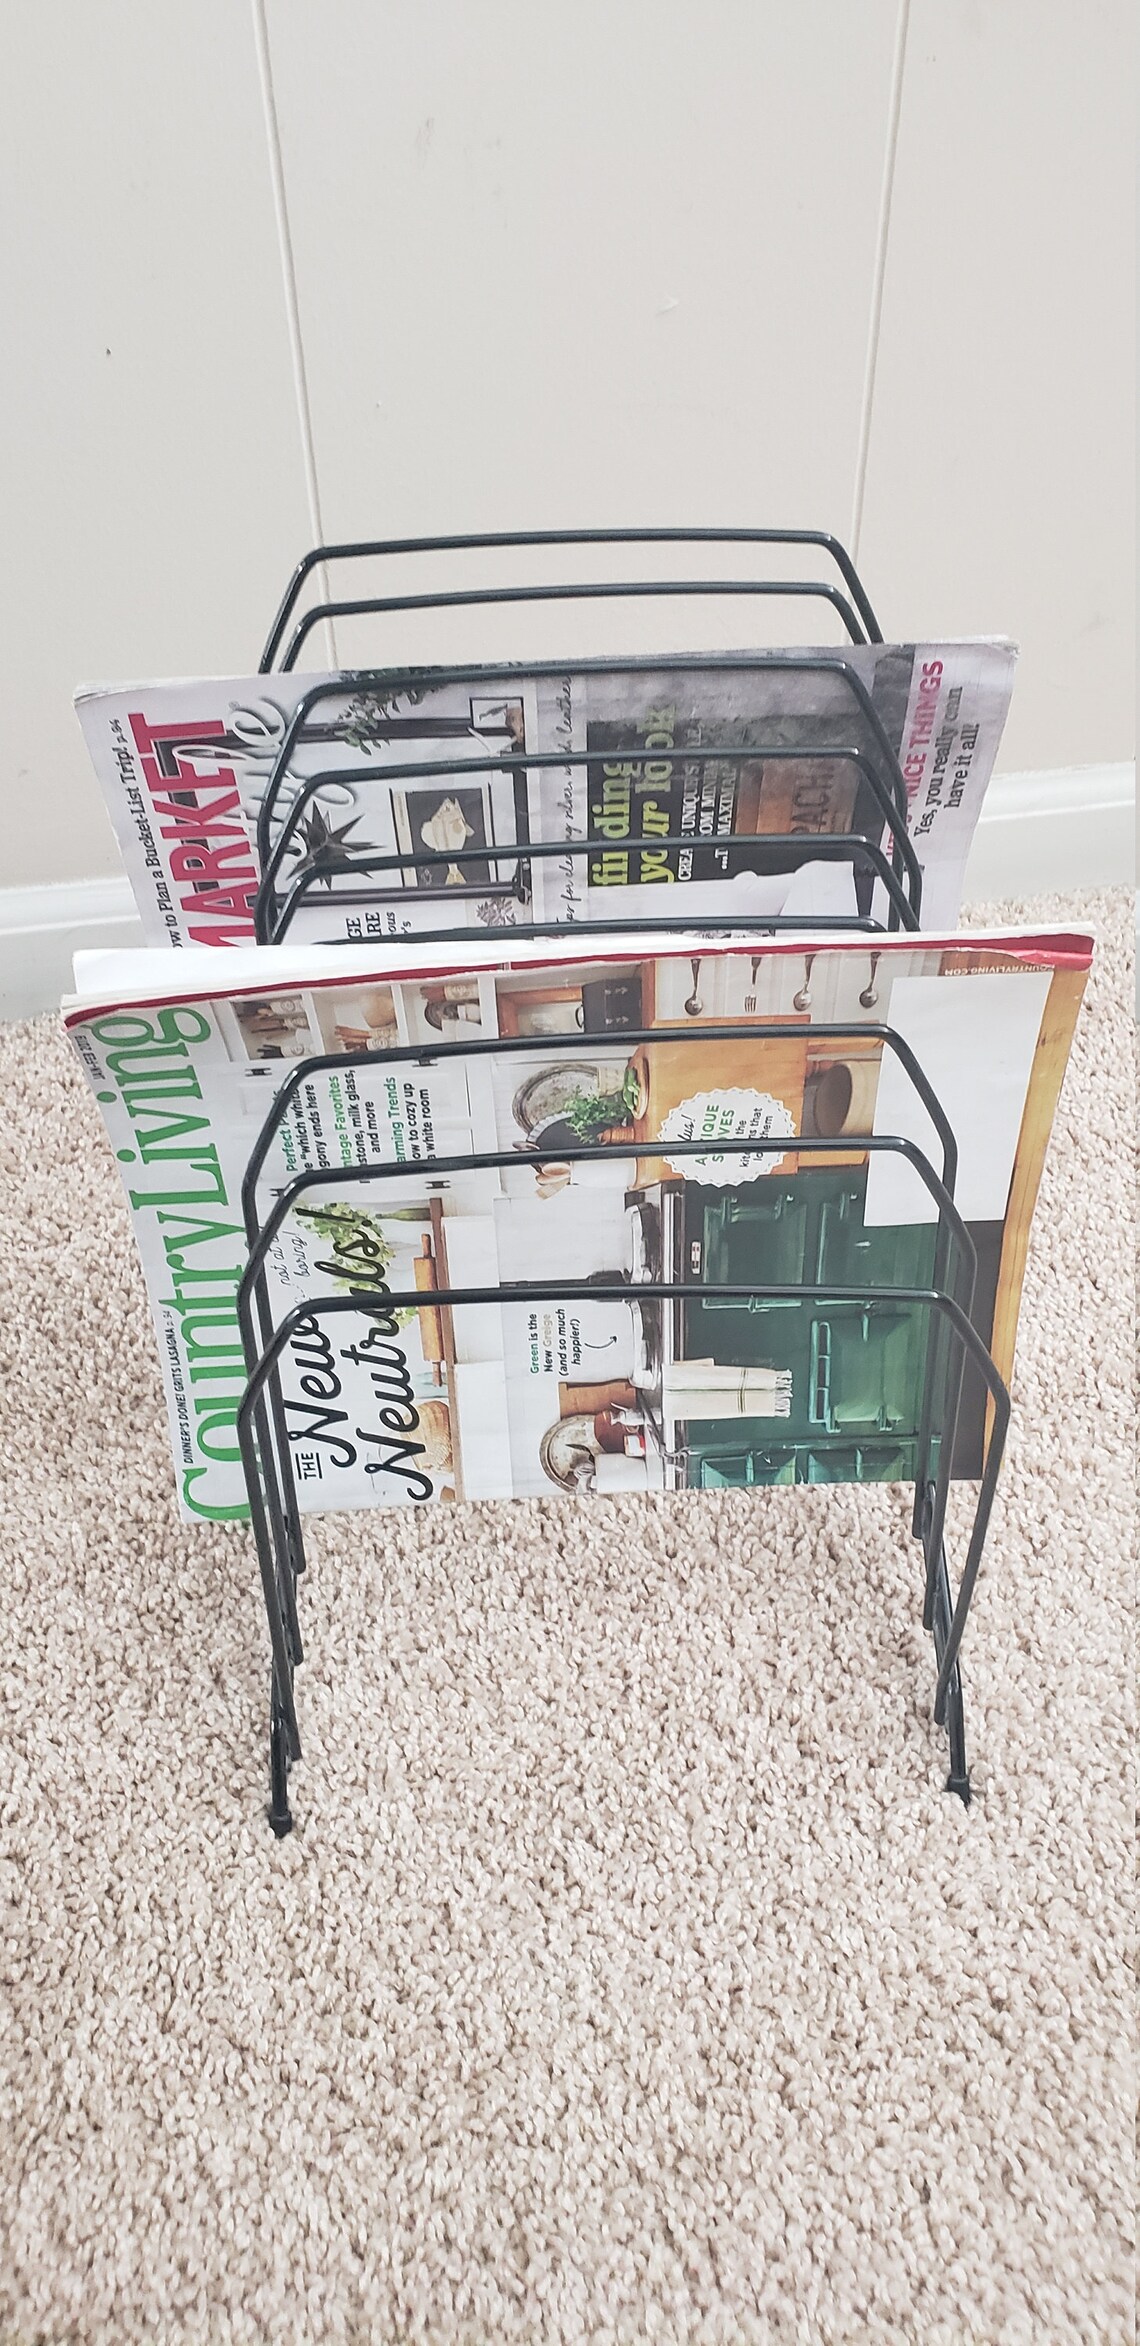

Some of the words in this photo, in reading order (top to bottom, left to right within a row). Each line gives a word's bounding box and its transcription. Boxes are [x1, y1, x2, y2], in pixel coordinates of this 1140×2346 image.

[910, 660, 944, 747] THINGS
[944, 686, 963, 723] can
[931, 724, 959, 774] really
[959, 723, 980, 750] all!
[112, 746, 137, 784] Trip!
[954, 754, 972, 766] it
[924, 776, 941, 806] you
[944, 769, 968, 808] have
[126, 786, 162, 868] Bucket-List
[913, 809, 938, 837] Yes,
[678, 831, 695, 881] CREAE
[152, 870, 164, 879] a
[154, 882, 175, 912] Plan
[164, 914, 178, 927] to
[944, 964, 1048, 976] OUNTRYLIVING.COM
[304, 1084, 318, 1109] here
[342, 1070, 360, 1101] glass,
[384, 1076, 401, 1118] Trends
[402, 1083, 416, 1098] up
[327, 1075, 348, 1130] Favorites
[347, 1103, 362, 1127] milk
[364, 1101, 378, 1130] more
[403, 1100, 418, 1126] cozy
[418, 1088, 432, 1118] room
[308, 1111, 323, 1137] ends
[677, 1114, 696, 1141] lus!
[734, 1120, 747, 1135] the
[749, 1108, 763, 1127] that
[760, 1115, 773, 1139] them
[367, 1132, 381, 1153] and
[390, 1122, 406, 1163] arming
[407, 1129, 419, 1141] to
[420, 1121, 436, 1152] white
[694, 1104, 720, 1166] AIQUE
[711, 1109, 735, 1162] SVES
[280, 1129, 298, 1172] Perfect
[314, 1140, 331, 1168] gony
[336, 1134, 353, 1168] ntage
[411, 1143, 421, 1159] ow
[268, 1247, 284, 1260] at
[282, 1230, 310, 1277] boring!
[270, 1264, 290, 1285] not
[527, 1313, 538, 1330] the
[542, 1313, 553, 1347] Greige
[555, 1308, 566, 1336] much
[164, 1328, 181, 1366] LASAGNA
[528, 1332, 538, 1341] is
[558, 1338, 567, 1350] so
[569, 1318, 582, 1365] happier!)
[295, 1206, 435, 1501] Neutrals!
[530, 1343, 539, 1374] Green
[543, 1350, 553, 1372] New
[557, 1352, 569, 1376] (and
[172, 1367, 185, 1392] GRITS
[175, 1393, 189, 1420] DONE!
[179, 1422, 194, 1464] DINNER'S
[300, 1453, 317, 1480] THE
